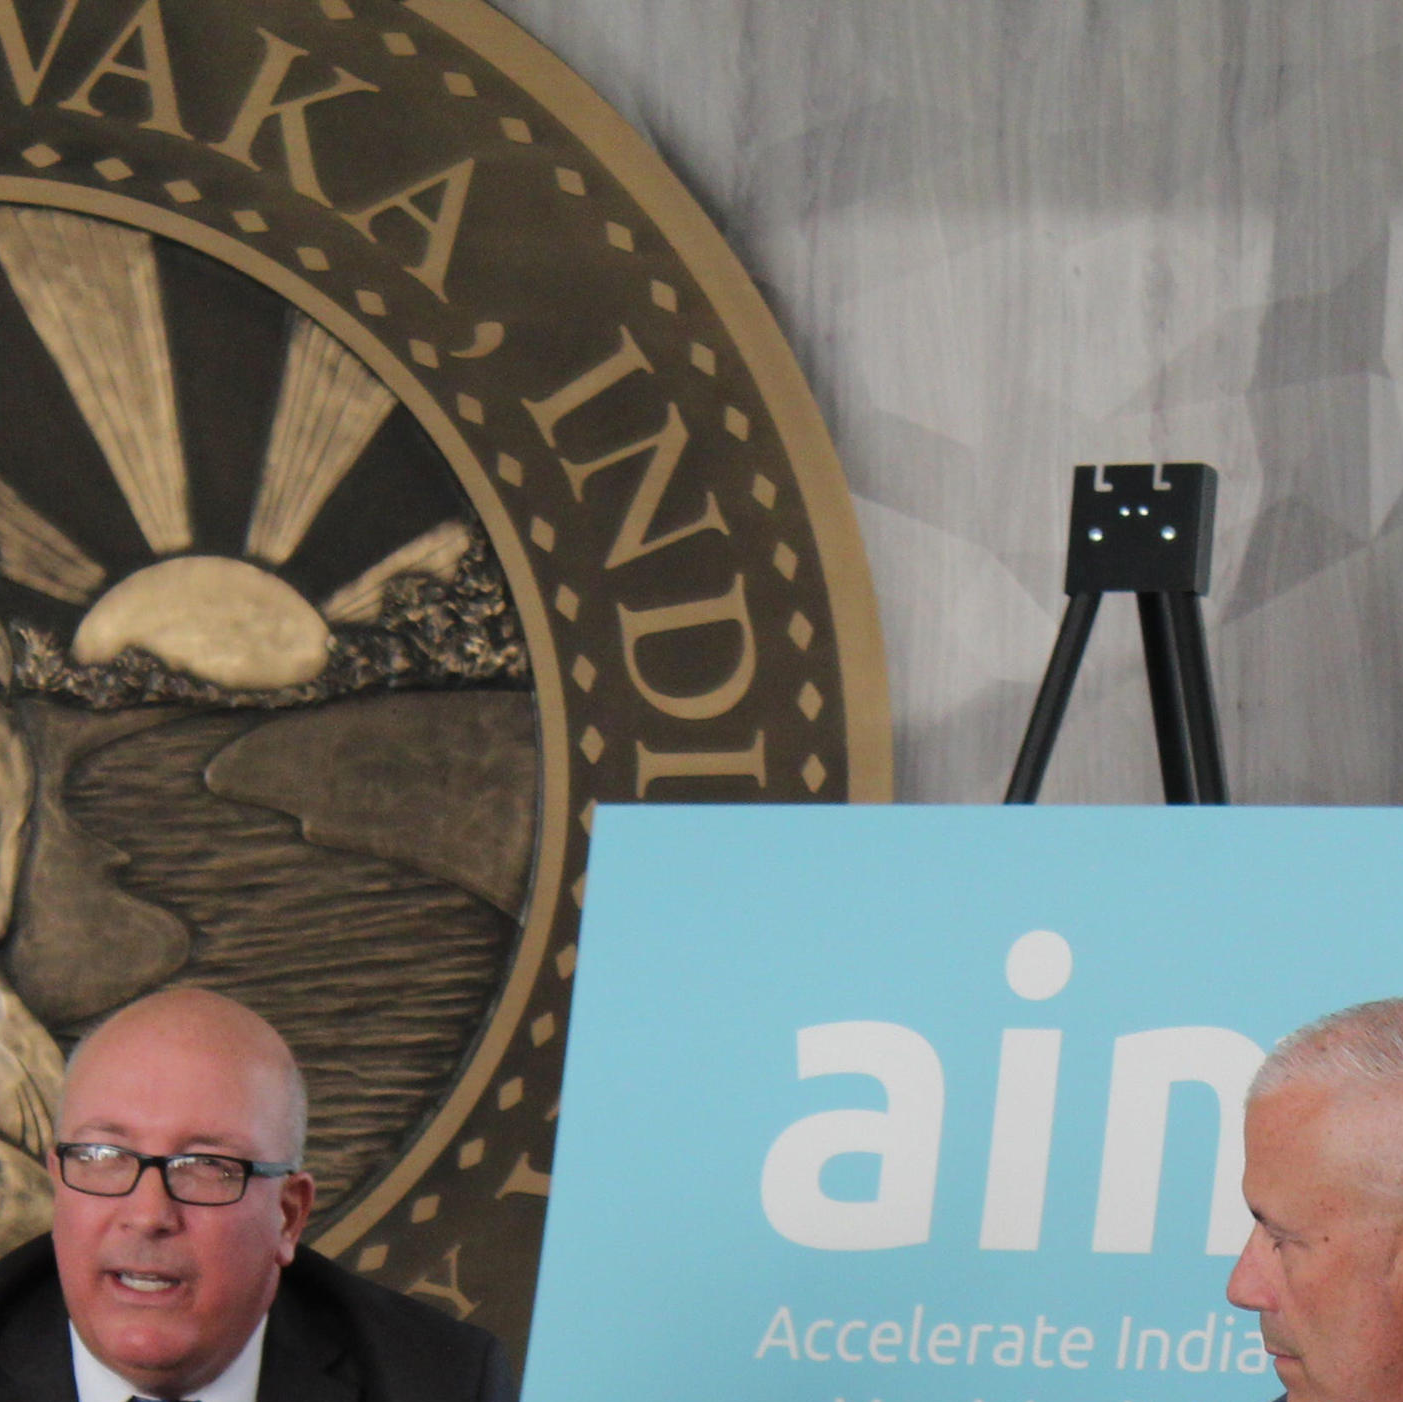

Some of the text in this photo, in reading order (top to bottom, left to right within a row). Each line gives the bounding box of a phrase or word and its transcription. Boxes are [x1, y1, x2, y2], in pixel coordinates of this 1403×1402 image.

[521, 324, 768, 798] INDI
[755, 1306, 1268, 1375] Accelerate India
